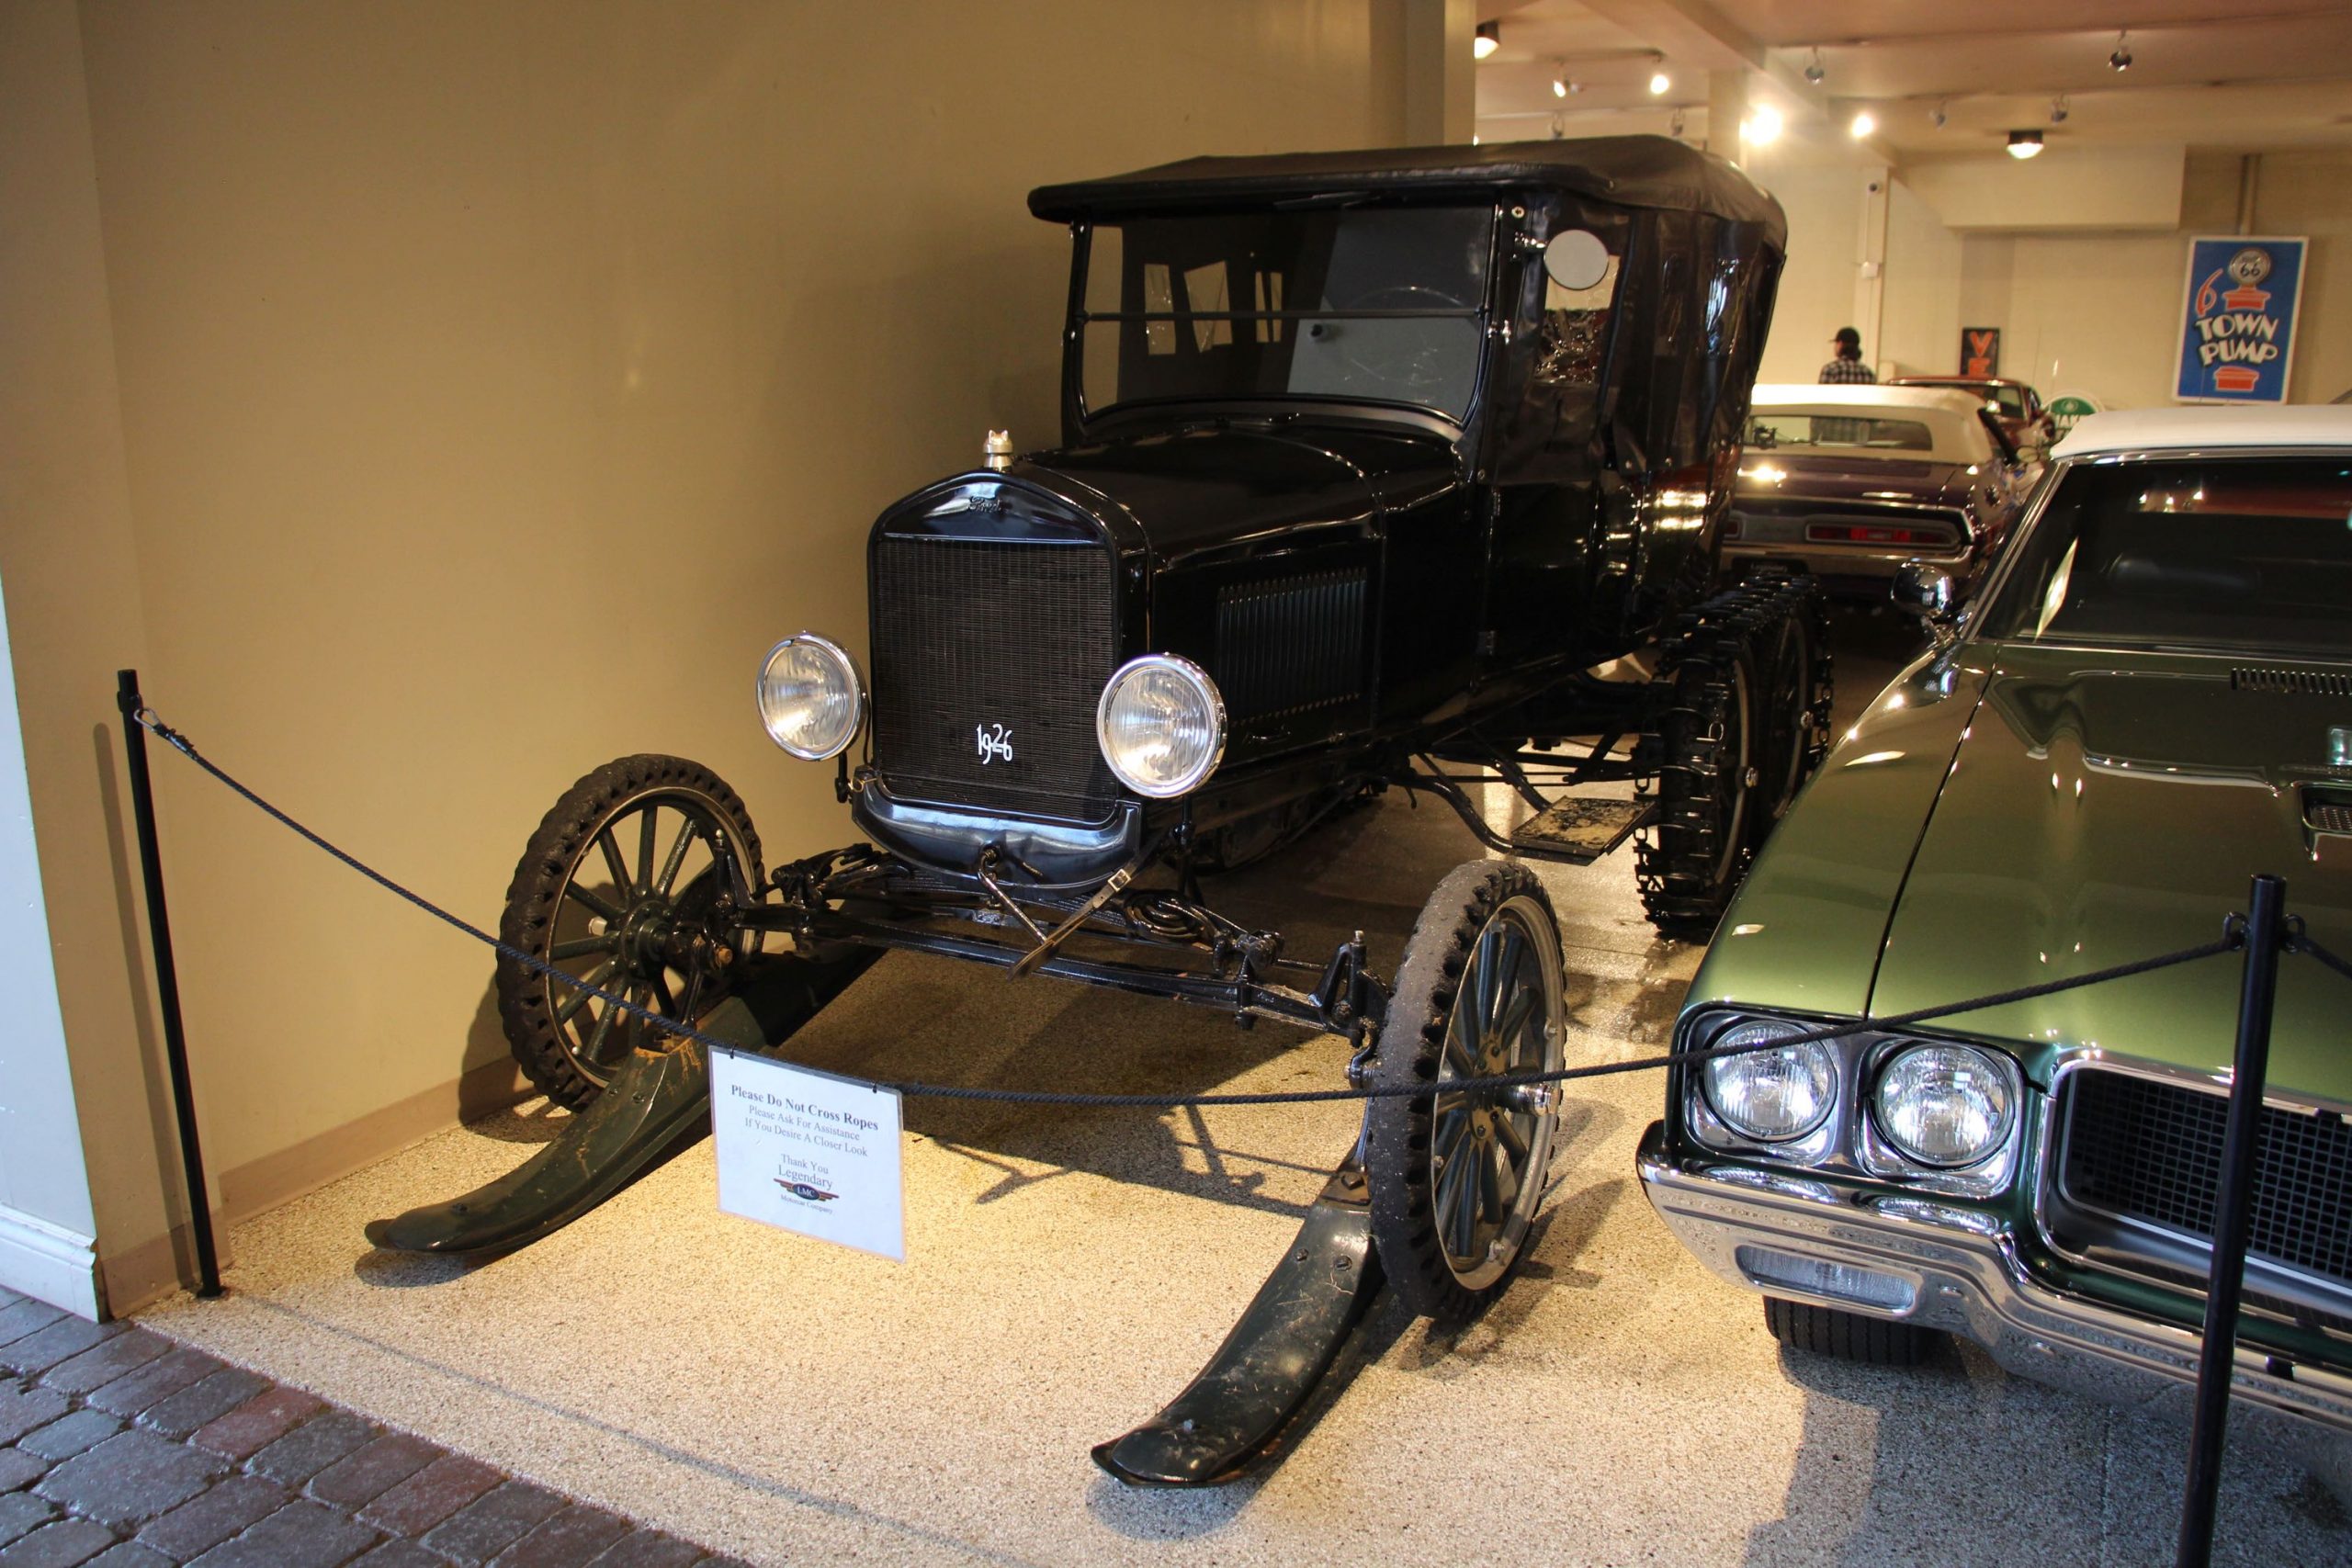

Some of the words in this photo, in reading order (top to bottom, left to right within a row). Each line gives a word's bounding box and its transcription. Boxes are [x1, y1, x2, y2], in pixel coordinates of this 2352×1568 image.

[2195, 312, 2278, 342] TOWN
[2199, 339, 2278, 366] PUMP
[976, 723, 1013, 765] 1926
[731, 1084, 763, 1102] Please
[767, 1093, 782, 1107] Do
[786, 1099, 805, 1112] Not
[808, 1104, 841, 1122] Cross
[843, 1112, 879, 1132] Ropes
[745, 1117, 754, 1127] If
[754, 1120, 773, 1134] You
[775, 1125, 801, 1141] Desire
[804, 1133, 812, 1143] A
[814, 1136, 842, 1151] Closer
[844, 1142, 868, 1157] Look
[749, 1105, 775, 1120] Please
[777, 1113, 794, 1124] Ask
[797, 1118, 811, 1129] For
[814, 1122, 860, 1141] Assistance
[778, 1165, 833, 1190] Legendary
[781, 1154, 808, 1169] Thank
[810, 1161, 829, 1175] You
[797, 1186, 815, 1198] LMC
[807, 1201, 833, 1214] Company
